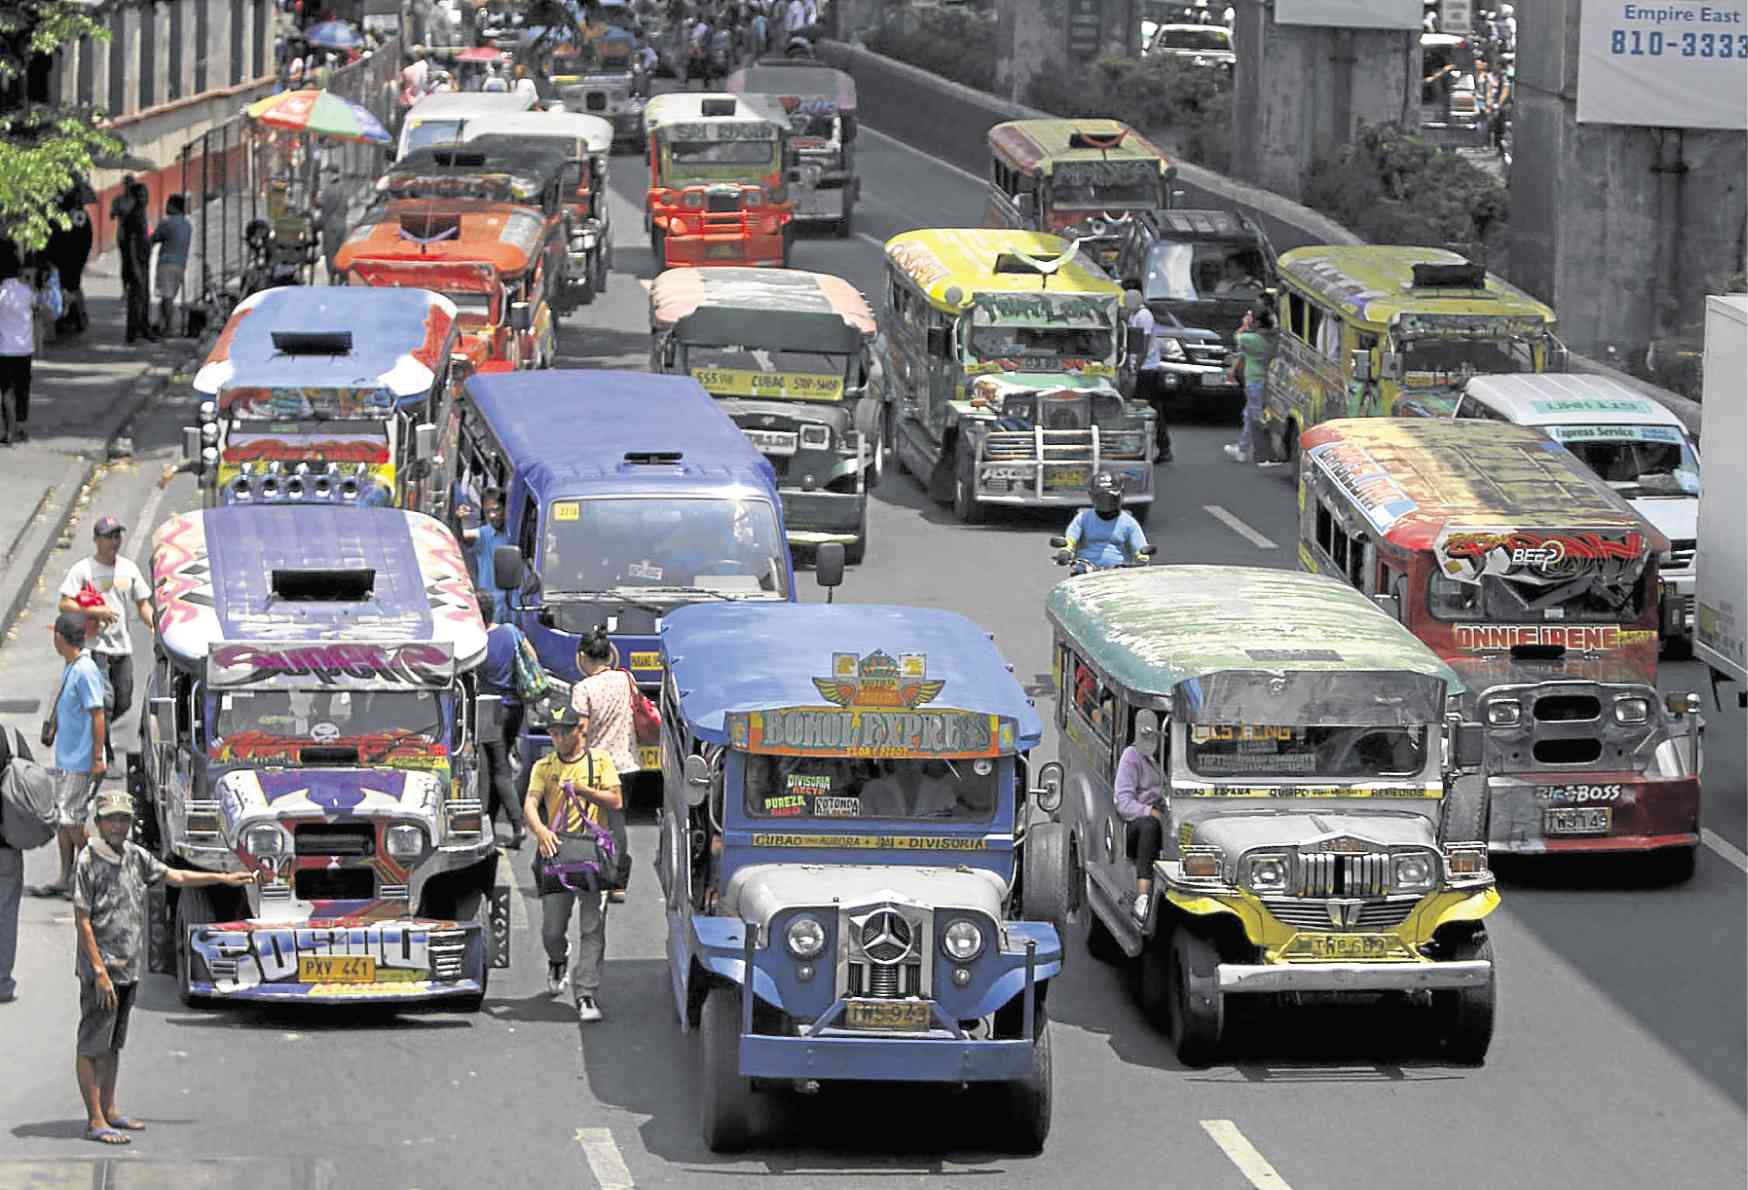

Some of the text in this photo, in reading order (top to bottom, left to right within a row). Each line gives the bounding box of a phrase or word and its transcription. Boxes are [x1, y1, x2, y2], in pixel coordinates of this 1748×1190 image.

[1624, 4, 1742, 24] Empire East
[1611, 30, 1748, 58] 810-3333
[1597, 427, 1636, 438] Service
[764, 710, 992, 748] BOHOL EXPRESS
[787, 774, 831, 790] DIVISORIA
[1371, 789, 1425, 797] REMEDIOS
[765, 795, 807, 809] PUREZA
[815, 798, 859, 814] ROTONDA
[755, 834, 802, 846] CUBAO
[908, 837, 984, 849] DIVISORIA
[342, 961, 369, 978] 441
